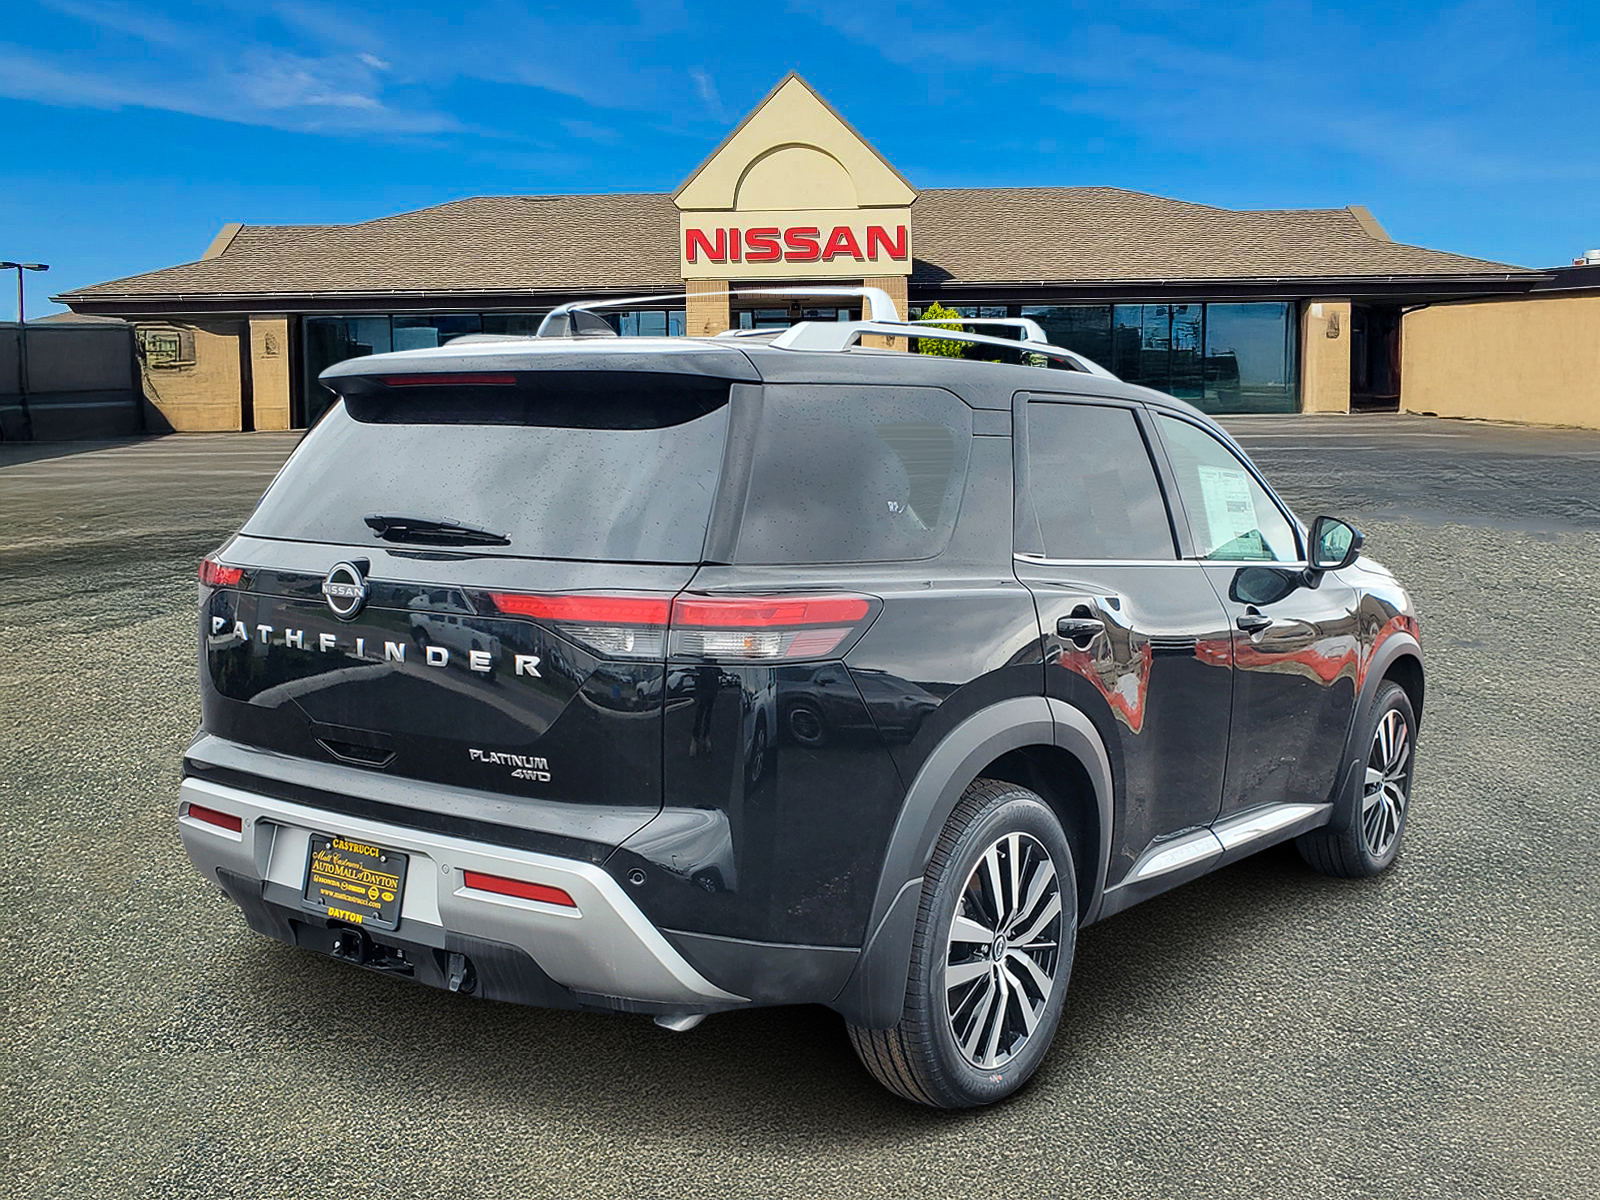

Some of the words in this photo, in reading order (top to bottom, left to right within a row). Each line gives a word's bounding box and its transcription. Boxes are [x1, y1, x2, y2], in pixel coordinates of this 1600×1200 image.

[685, 225, 907, 262] NISSAN
[322, 584, 364, 598] NISSAN
[211, 616, 542, 678] PATHFINDER
[468, 748, 549, 770] PLATINUM
[510, 768, 551, 782] 4WD
[332, 838, 380, 858] CASTRUCCI
[327, 906, 364, 924] DAYTON
